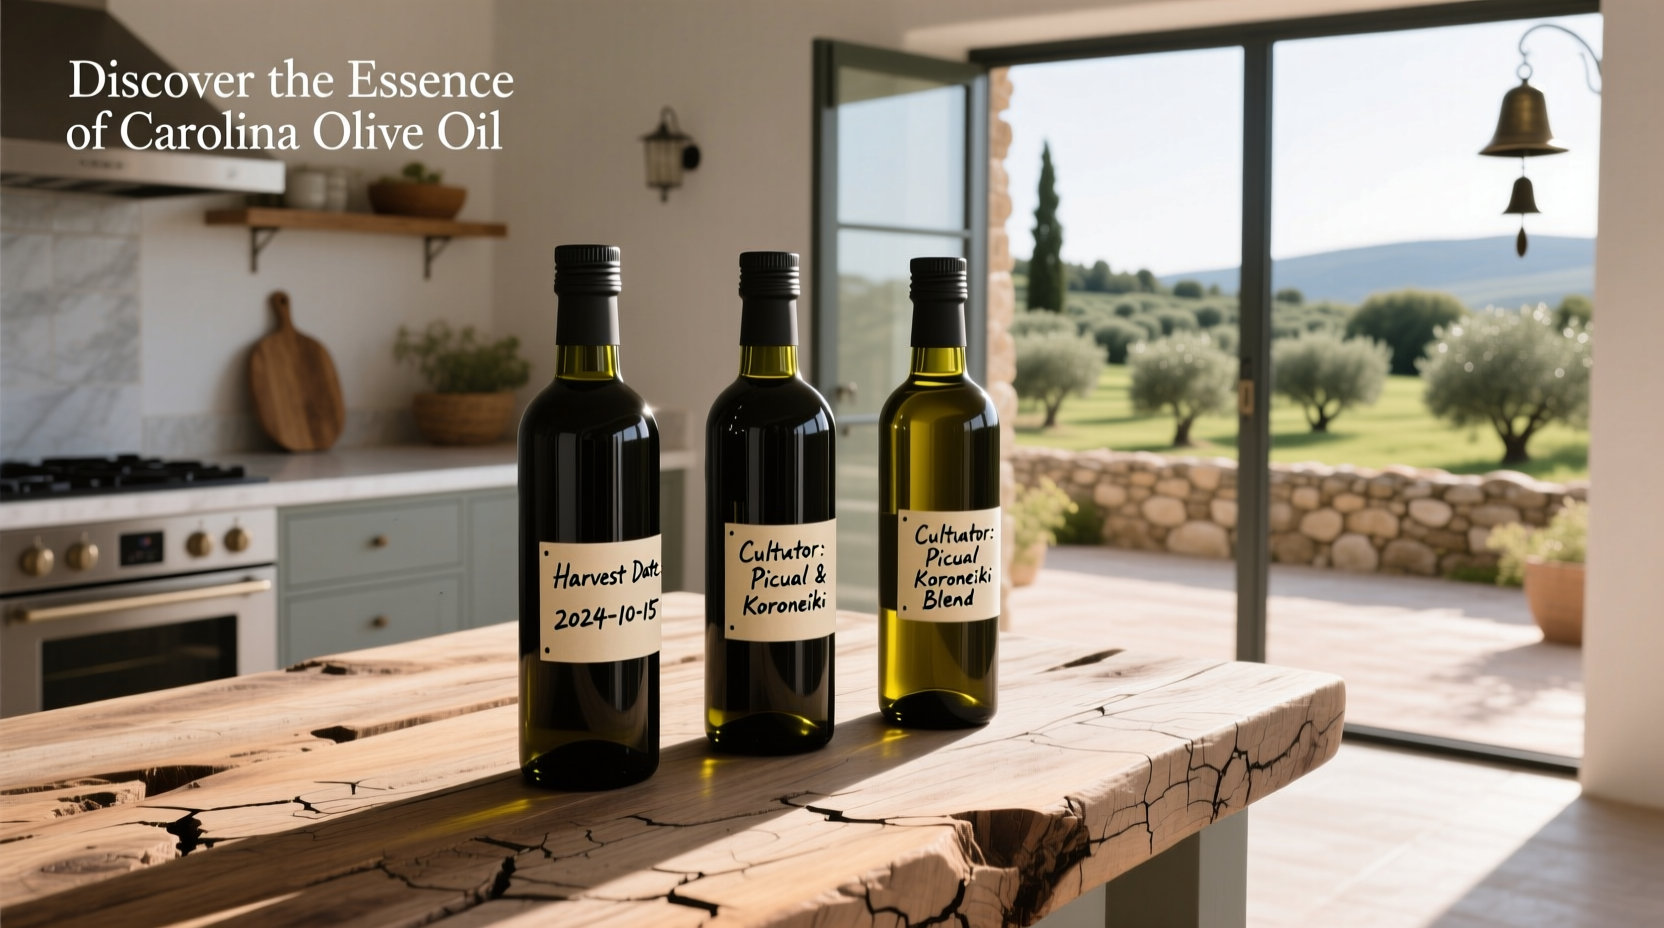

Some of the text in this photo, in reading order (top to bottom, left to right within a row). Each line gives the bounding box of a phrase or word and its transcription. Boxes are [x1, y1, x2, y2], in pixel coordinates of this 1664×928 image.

[926, 545, 979, 567] Picual
[553, 562, 627, 589] Harvest
[751, 563, 826, 590] Picual &
[914, 565, 992, 588] Koroneiki
[743, 589, 827, 616] Koroneiki
[923, 588, 975, 610] Blend
[554, 598, 659, 630] 2024-10-15
